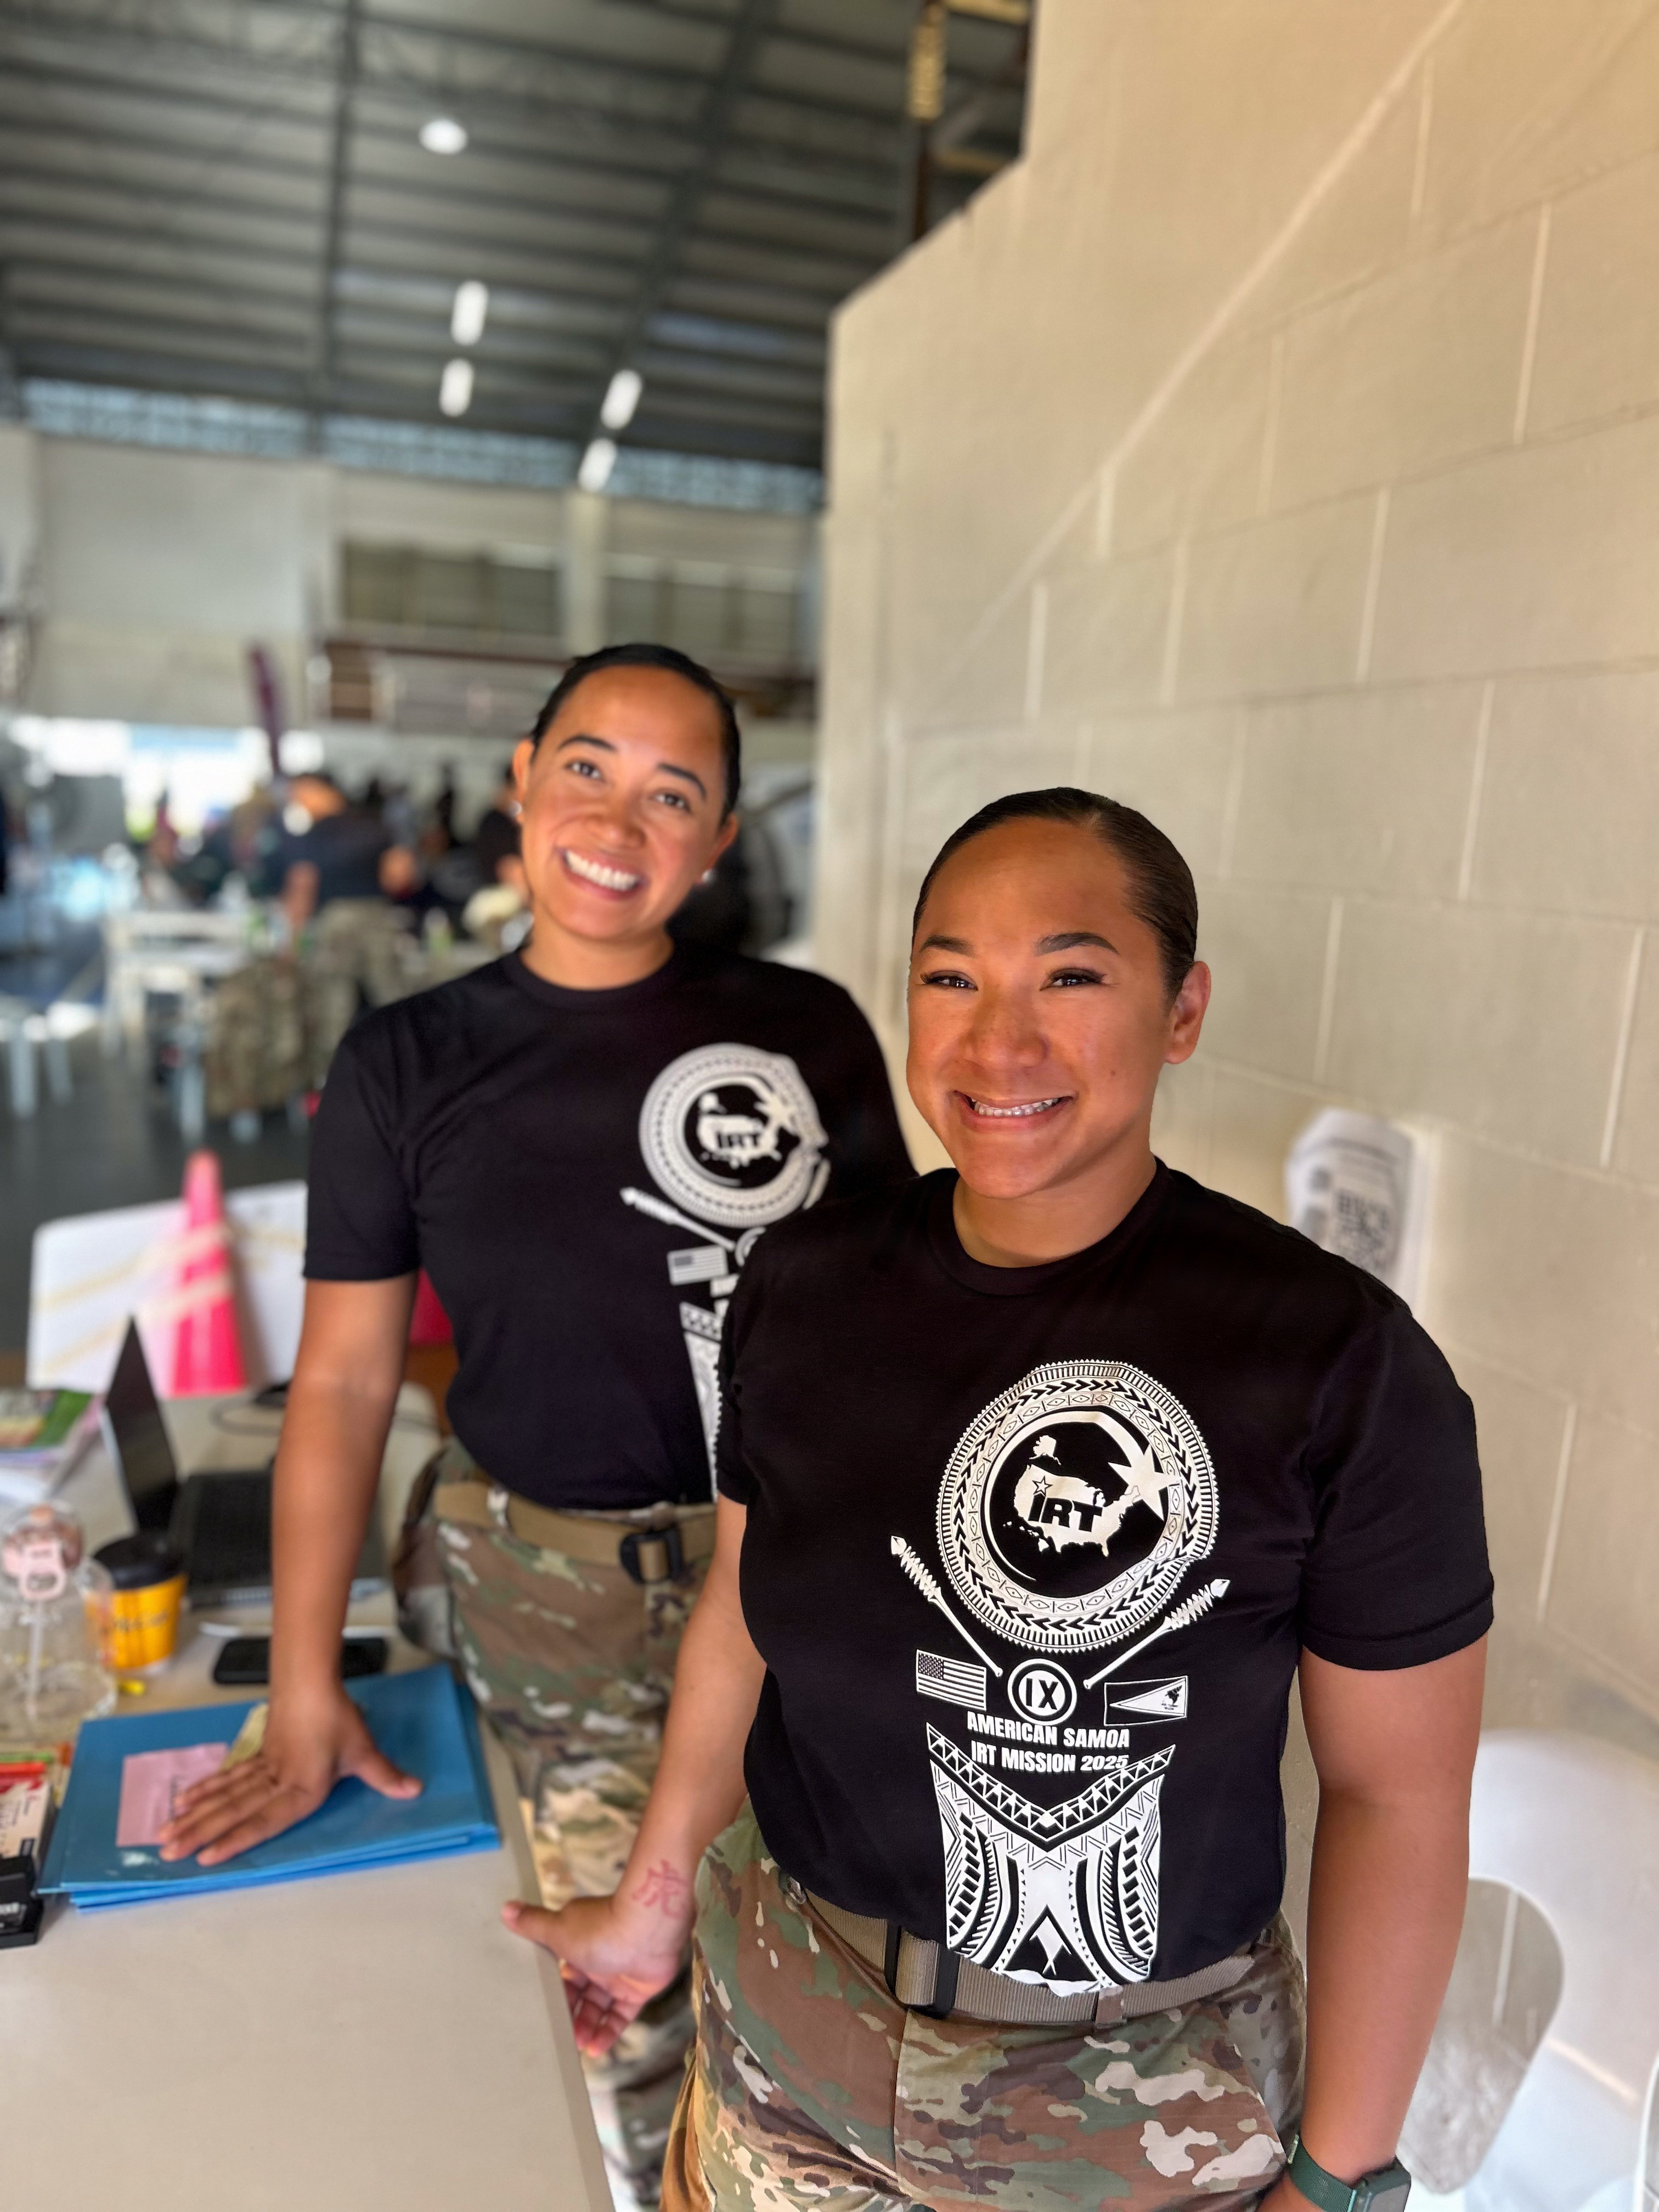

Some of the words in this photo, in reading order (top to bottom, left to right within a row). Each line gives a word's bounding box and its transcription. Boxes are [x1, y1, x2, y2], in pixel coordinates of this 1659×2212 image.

[716, 1132, 760, 1148] IRT
[1028, 1494, 1102, 1532] IRT
[1025, 1678, 1059, 1710] IX
[967, 1711, 1057, 1745] AMERICAN
[1063, 1728, 1129, 1748] SAMOA
[970, 1740, 996, 1765] IRT
[1001, 1747, 1076, 1773] MISSION
[1080, 1754, 1129, 1771] 2025
